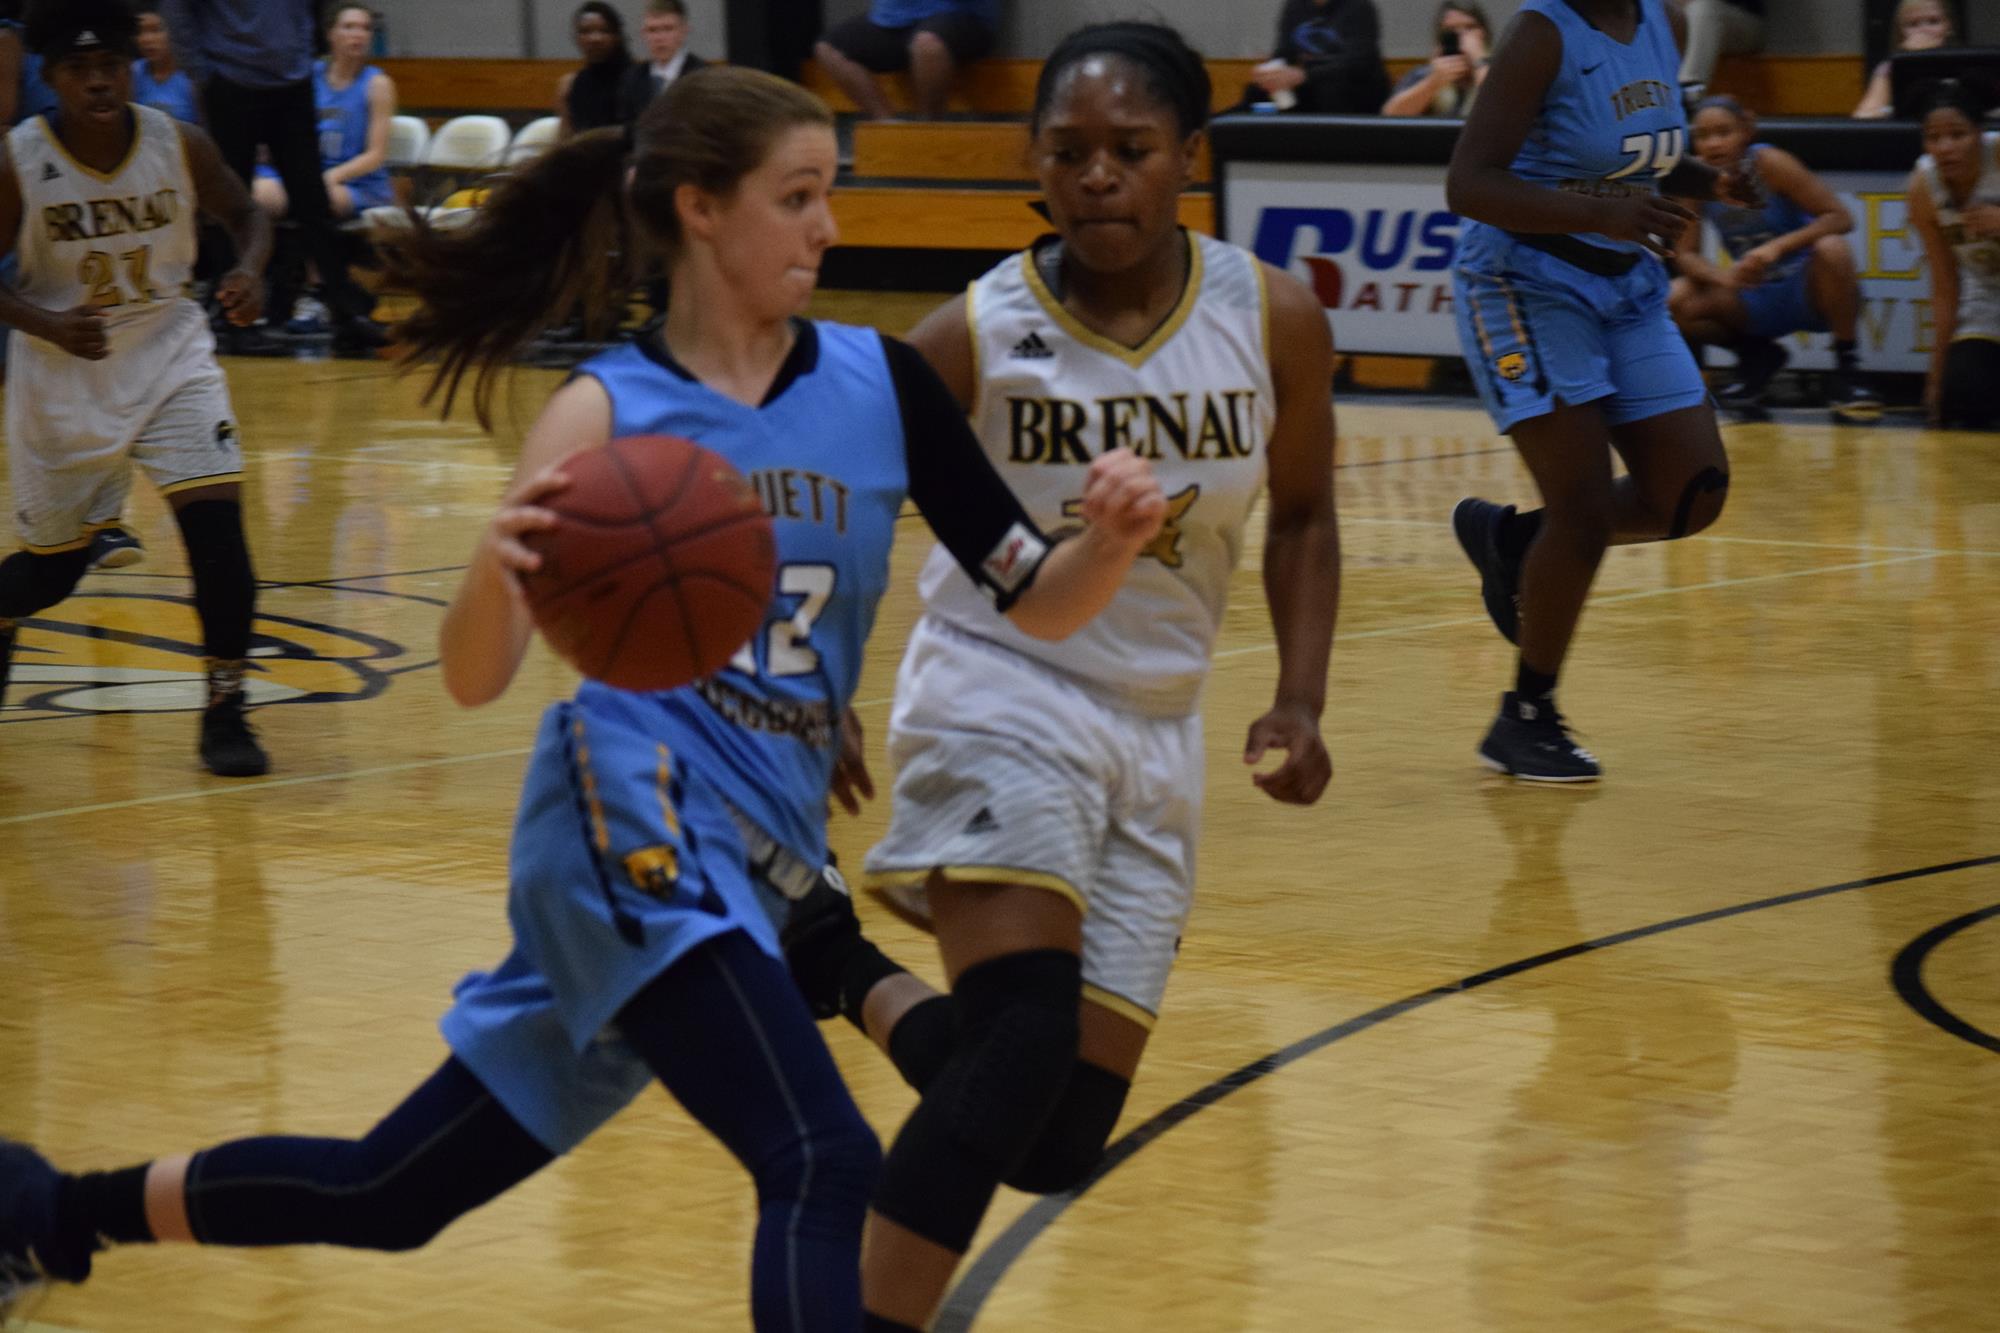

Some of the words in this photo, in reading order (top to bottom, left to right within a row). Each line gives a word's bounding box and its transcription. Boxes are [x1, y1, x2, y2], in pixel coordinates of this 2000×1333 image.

[44, 188, 178, 241] BRENAU
[79, 245, 155, 307] 21
[1006, 391, 1256, 464] BRENAU
